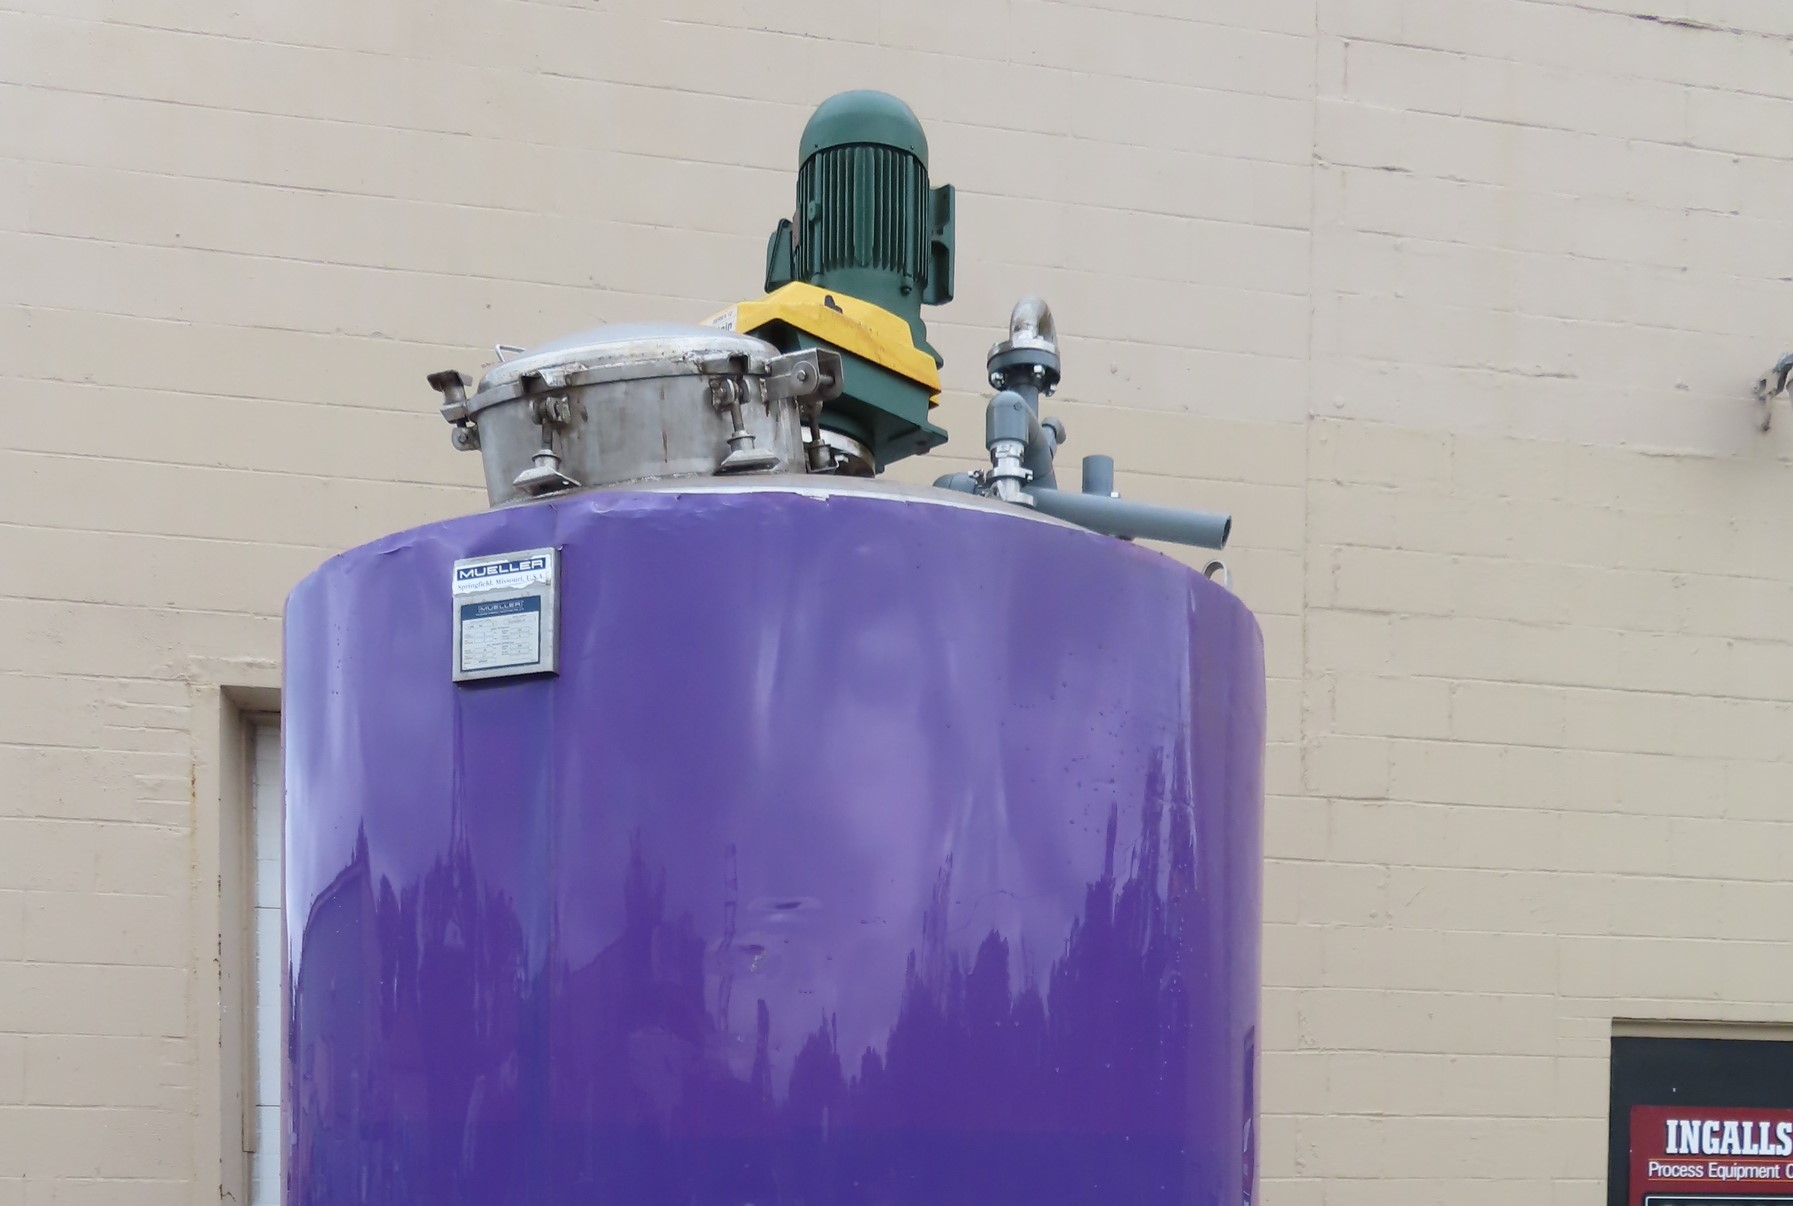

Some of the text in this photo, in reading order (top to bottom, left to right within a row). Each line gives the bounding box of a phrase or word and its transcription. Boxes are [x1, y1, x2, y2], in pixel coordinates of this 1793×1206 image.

[460, 559, 543, 579] MUELLER
[458, 579, 493, 591] Springfield,
[495, 575, 525, 585] Missouri,
[1666, 1119, 1793, 1156] INGALLS
[1648, 1161, 1704, 1178] Process
[1708, 1162, 1780, 1181] Equipment
